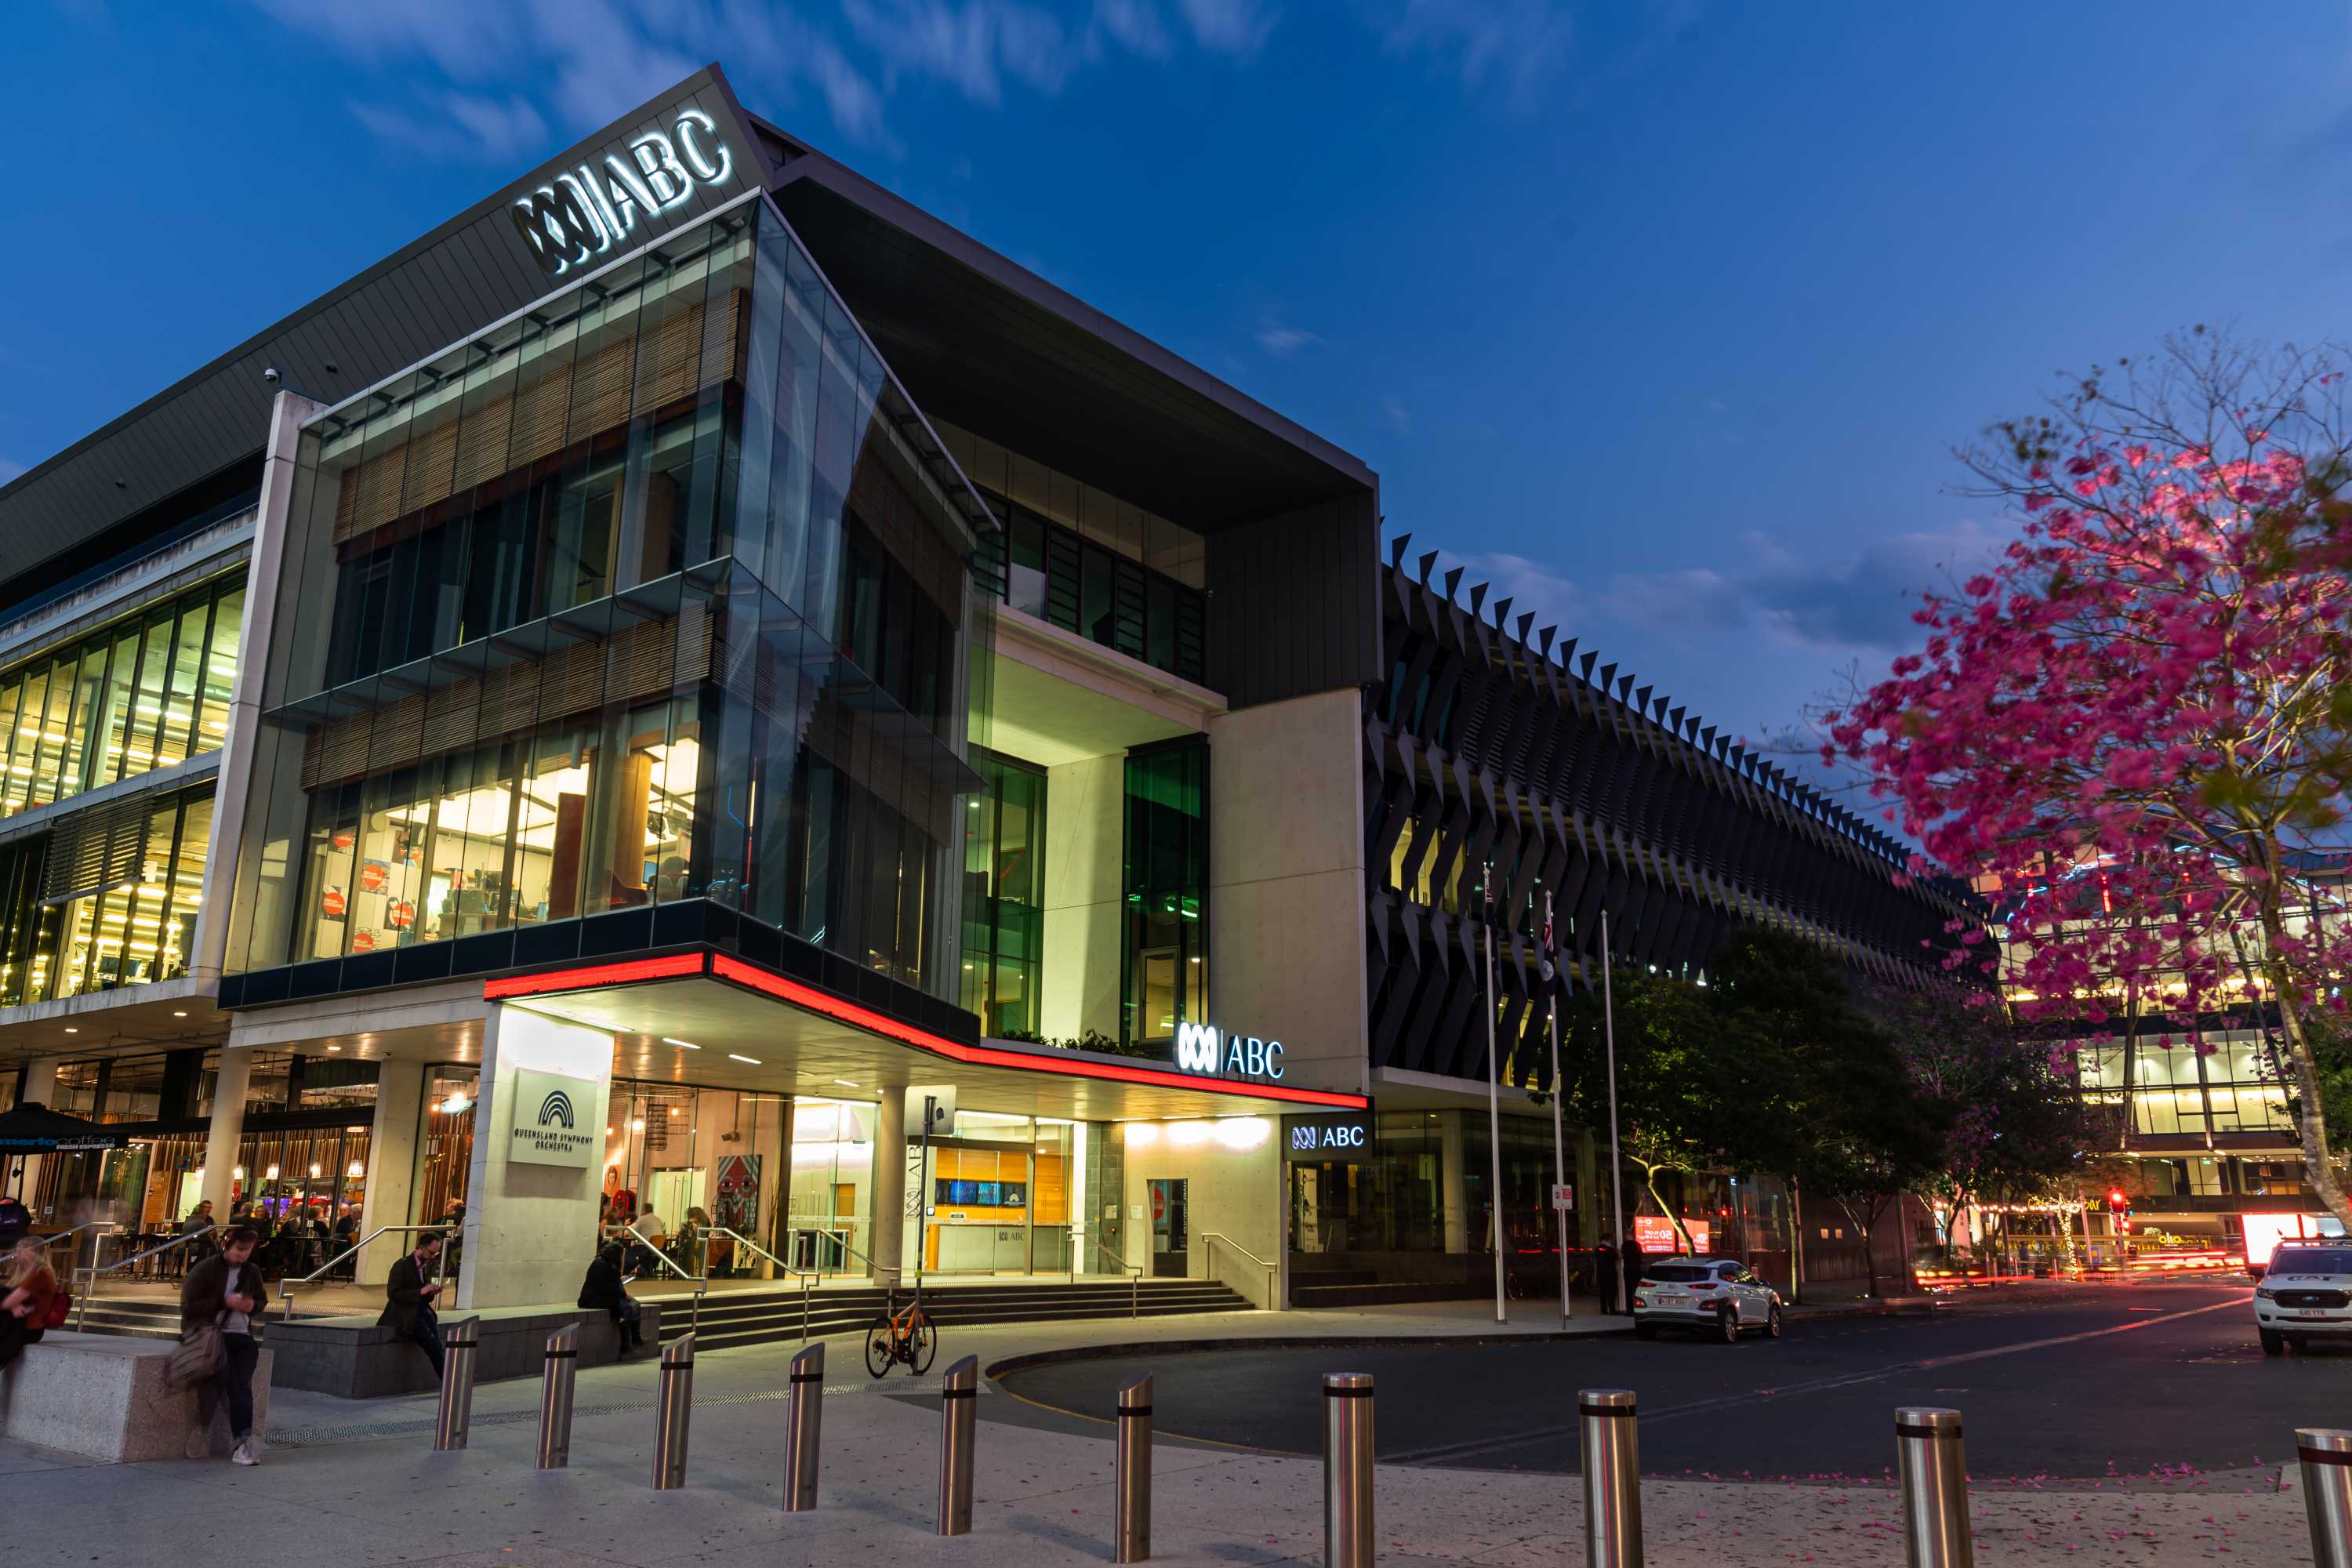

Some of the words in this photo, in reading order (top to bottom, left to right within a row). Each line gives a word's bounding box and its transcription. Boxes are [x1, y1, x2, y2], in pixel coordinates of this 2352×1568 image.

[603, 111, 730, 230] ABC
[1226, 1035, 1284, 1079] ABC
[514, 1128, 558, 1142] QUEENSLAND
[560, 1134, 593, 1145] SYMPHONY
[535, 1140, 572, 1152] ORCHESTRA
[1323, 1126, 1364, 1147] ABC
[909, 1146, 922, 1178] AB
